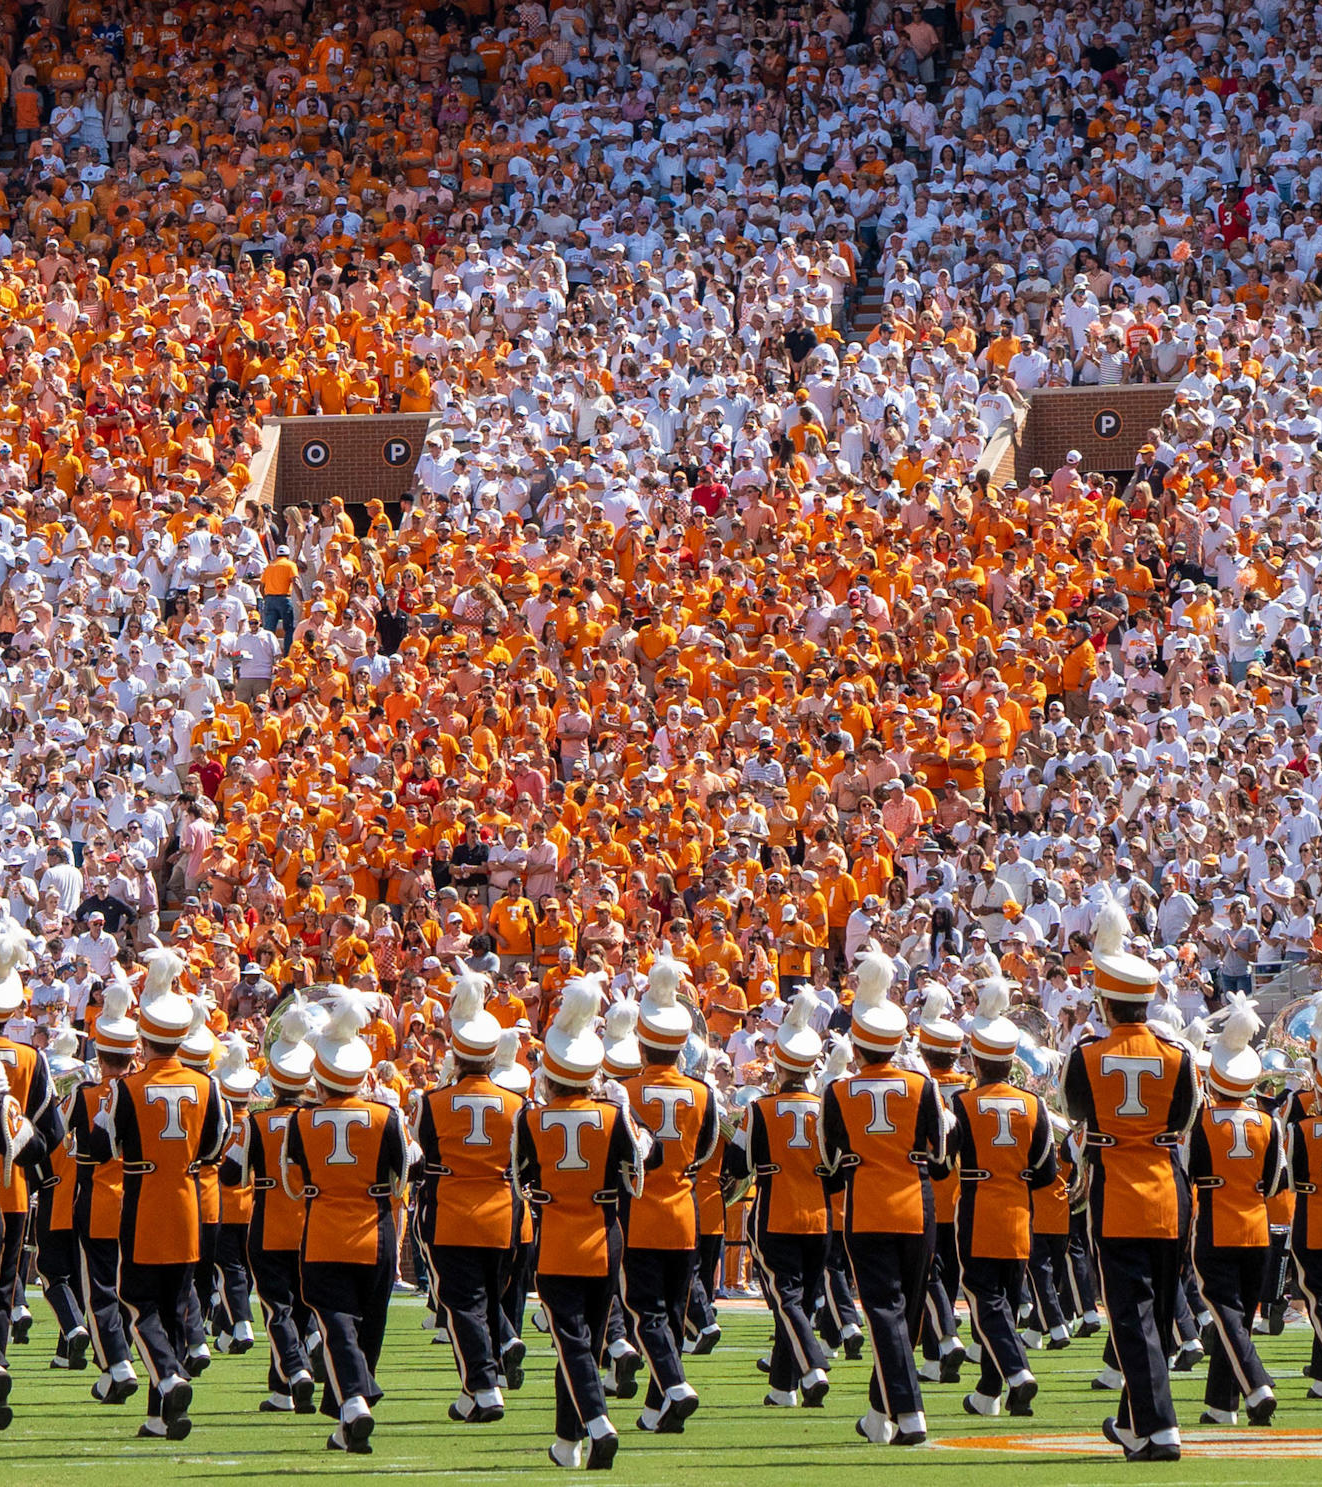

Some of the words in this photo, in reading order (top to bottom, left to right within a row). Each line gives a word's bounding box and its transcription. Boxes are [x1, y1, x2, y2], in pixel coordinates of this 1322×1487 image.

[132, 31, 144, 45] 16
[327, 47, 342, 63] 16
[1224, 211, 1233, 225] 3
[394, 360, 404, 378] 6
[292, 398, 298, 414] 1
[1101, 415, 1116, 434] P
[306, 444, 325, 463] O
[390, 443, 406, 462] P
[889, 583, 895, 603] 1
[97, 597, 111, 610] T
[737, 868, 747, 887] 6
[828, 886, 836, 907] 1
[507, 905, 522, 921] T
[1100, 1055, 1164, 1117] T
[145, 1085, 199, 1140] T
[642, 1085, 694, 1140] T
[848, 1079, 908, 1135] T
[451, 1095, 504, 1146] T
[776, 1101, 820, 1149] T
[978, 1097, 1027, 1147] T
[312, 1108, 371, 1166] T
[540, 1109, 603, 1171] T
[1213, 1109, 1263, 1160] T
